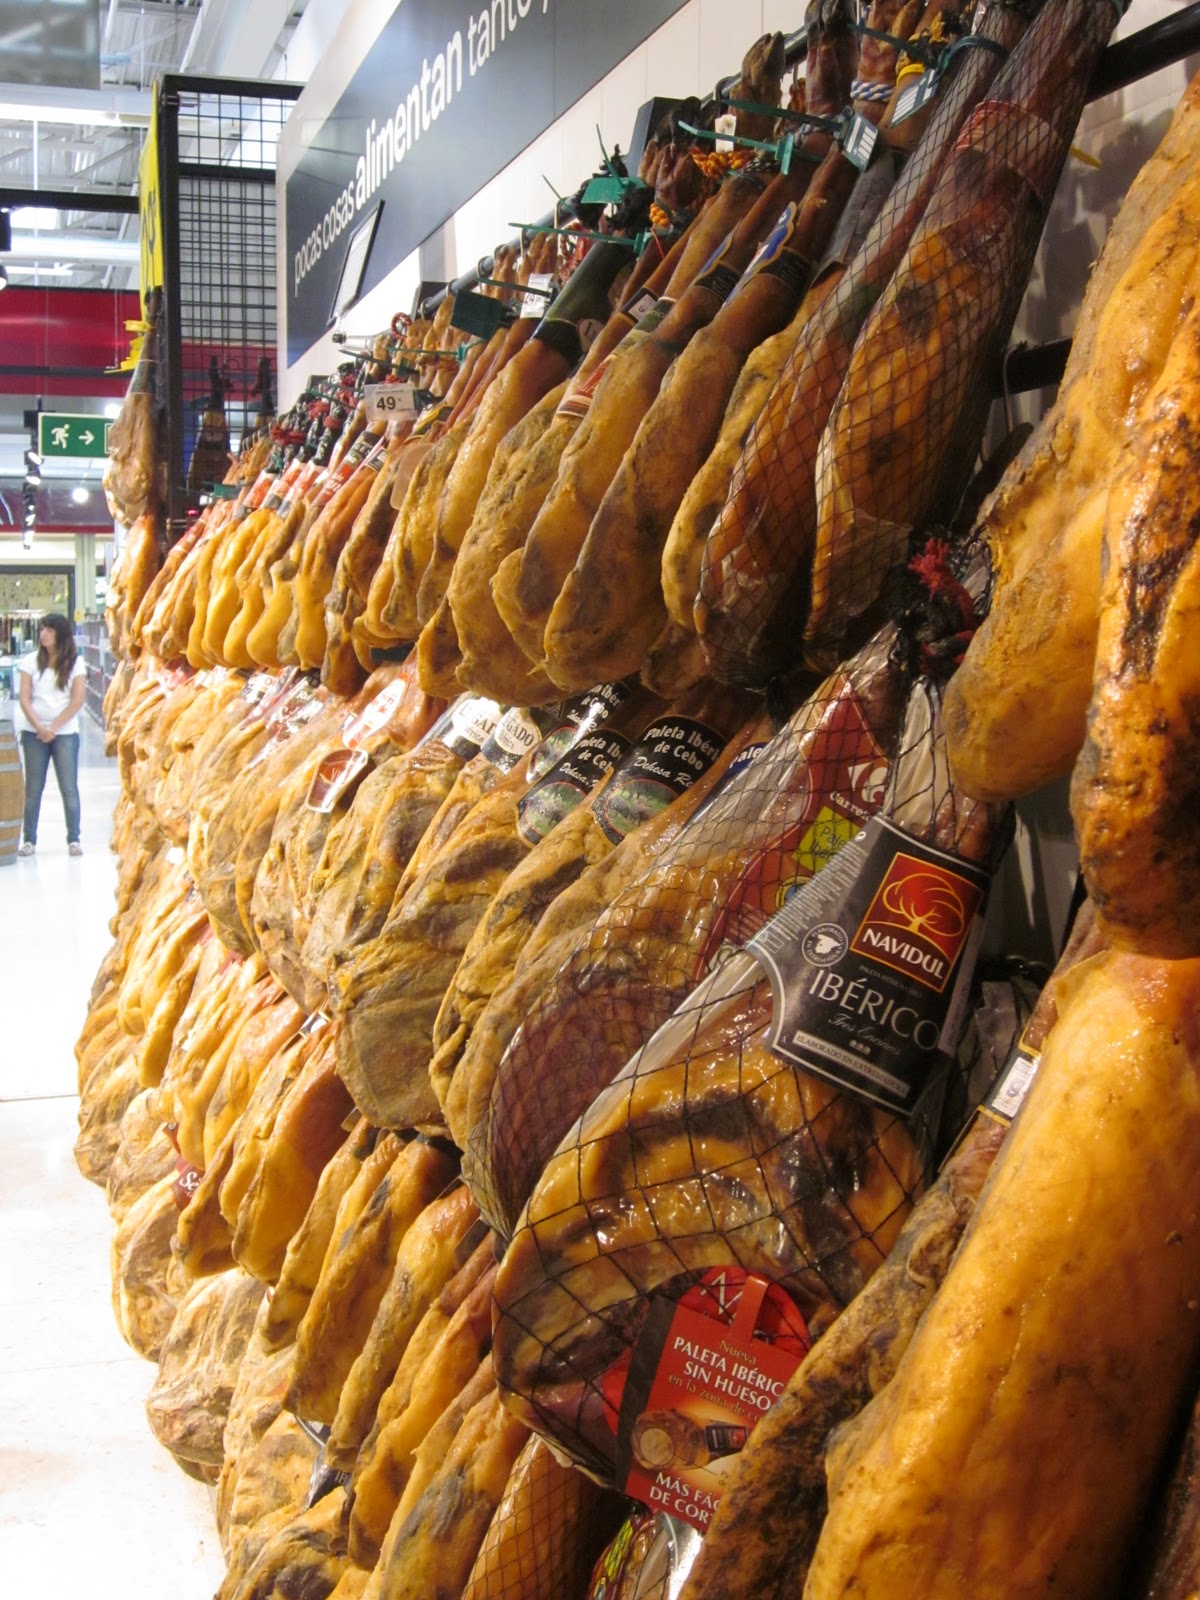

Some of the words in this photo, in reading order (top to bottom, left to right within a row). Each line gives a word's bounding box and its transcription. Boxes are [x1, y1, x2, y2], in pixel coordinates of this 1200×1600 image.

[294, 223, 322, 298] pocas
[323, 180, 354, 250] cosas
[355, 30, 462, 211] alimentan
[376, 396, 396, 411] 49
[578, 749, 592, 761] de
[634, 756, 672, 778] Dehesa
[654, 740, 671, 754] de
[674, 745, 703, 770] Cebo
[862, 928, 945, 980] NAVIDUL
[808, 969, 941, 1050] IBÉRICO
[796, 1036, 844, 1061] ELABORADO
[673, 1336, 727, 1372] PALETA
[719, 1339, 757, 1365] Nueva
[668, 1375, 684, 1388] en
[685, 1378, 697, 1393] la
[699, 1388, 728, 1410] zona
[730, 1401, 746, 1415] de
[683, 1361, 712, 1384] SIN
[714, 1376, 771, 1411] HUESO
[655, 1471, 690, 1498] MÁS
[649, 1486, 670, 1506] DE
[674, 1498, 713, 1525] COR
